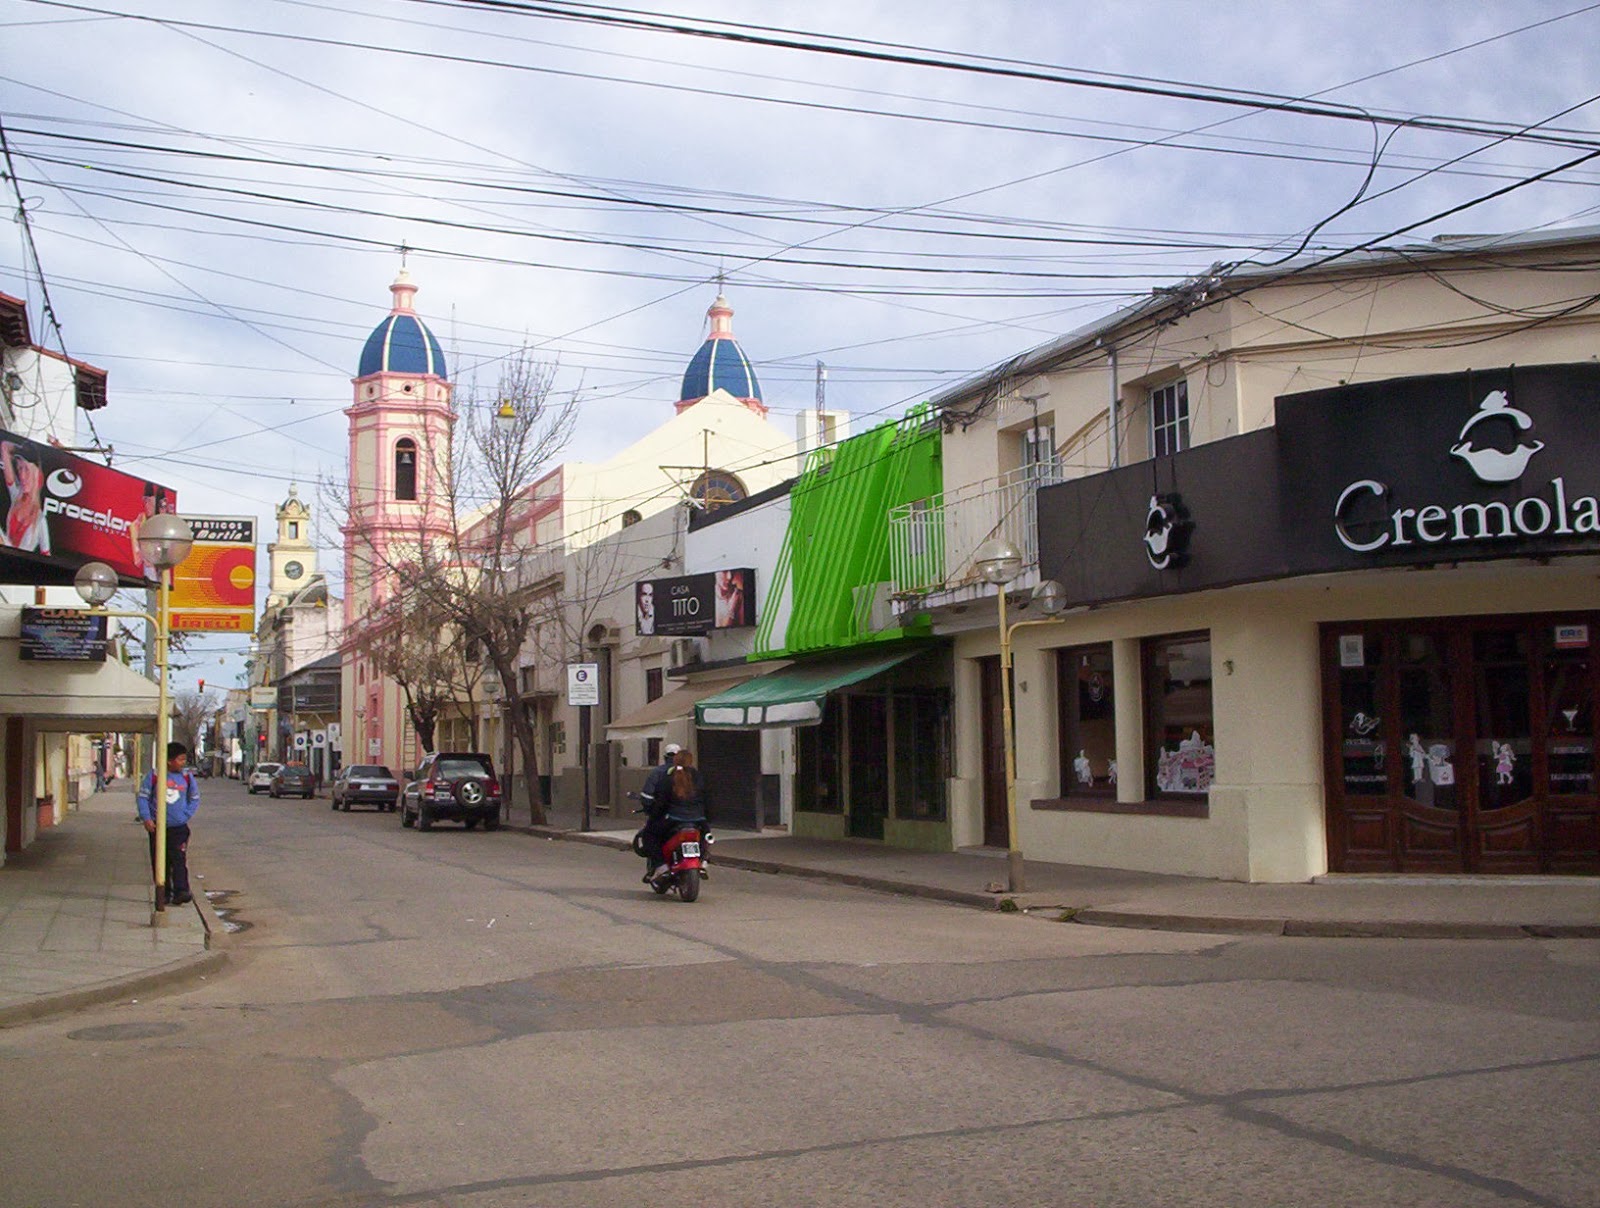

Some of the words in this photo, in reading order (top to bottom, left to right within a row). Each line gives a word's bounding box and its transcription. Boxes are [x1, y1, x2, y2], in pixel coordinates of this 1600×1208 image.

[43, 497, 132, 532] procolor
[1335, 477, 1600, 552] Cremola
[671, 585, 690, 595] CASA
[672, 597, 700, 616] TITO
[172, 614, 241, 628] PIRELLI
